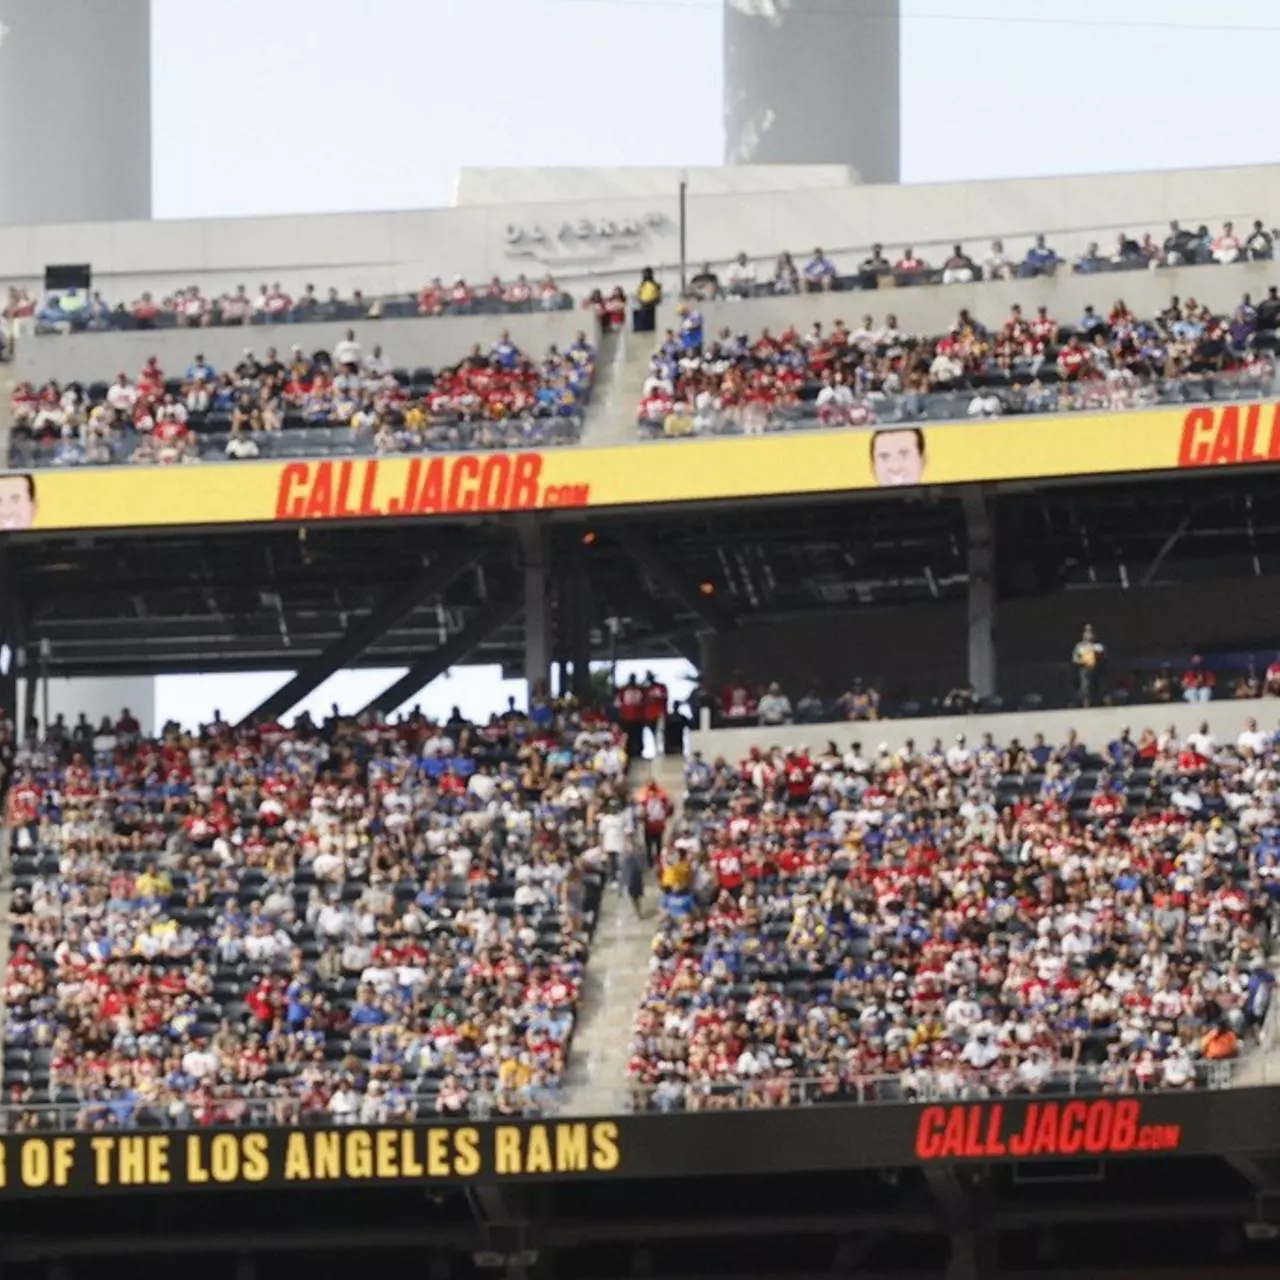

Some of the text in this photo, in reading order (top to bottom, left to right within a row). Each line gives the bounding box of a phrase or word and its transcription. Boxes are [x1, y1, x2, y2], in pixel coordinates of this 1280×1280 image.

[21, 1138, 76, 1186] OF
[92, 1136, 170, 1184] THE
[187, 1133, 269, 1183] LOS
[284, 1127, 480, 1180] ANGELES
[494, 1121, 620, 1175] RAMS
